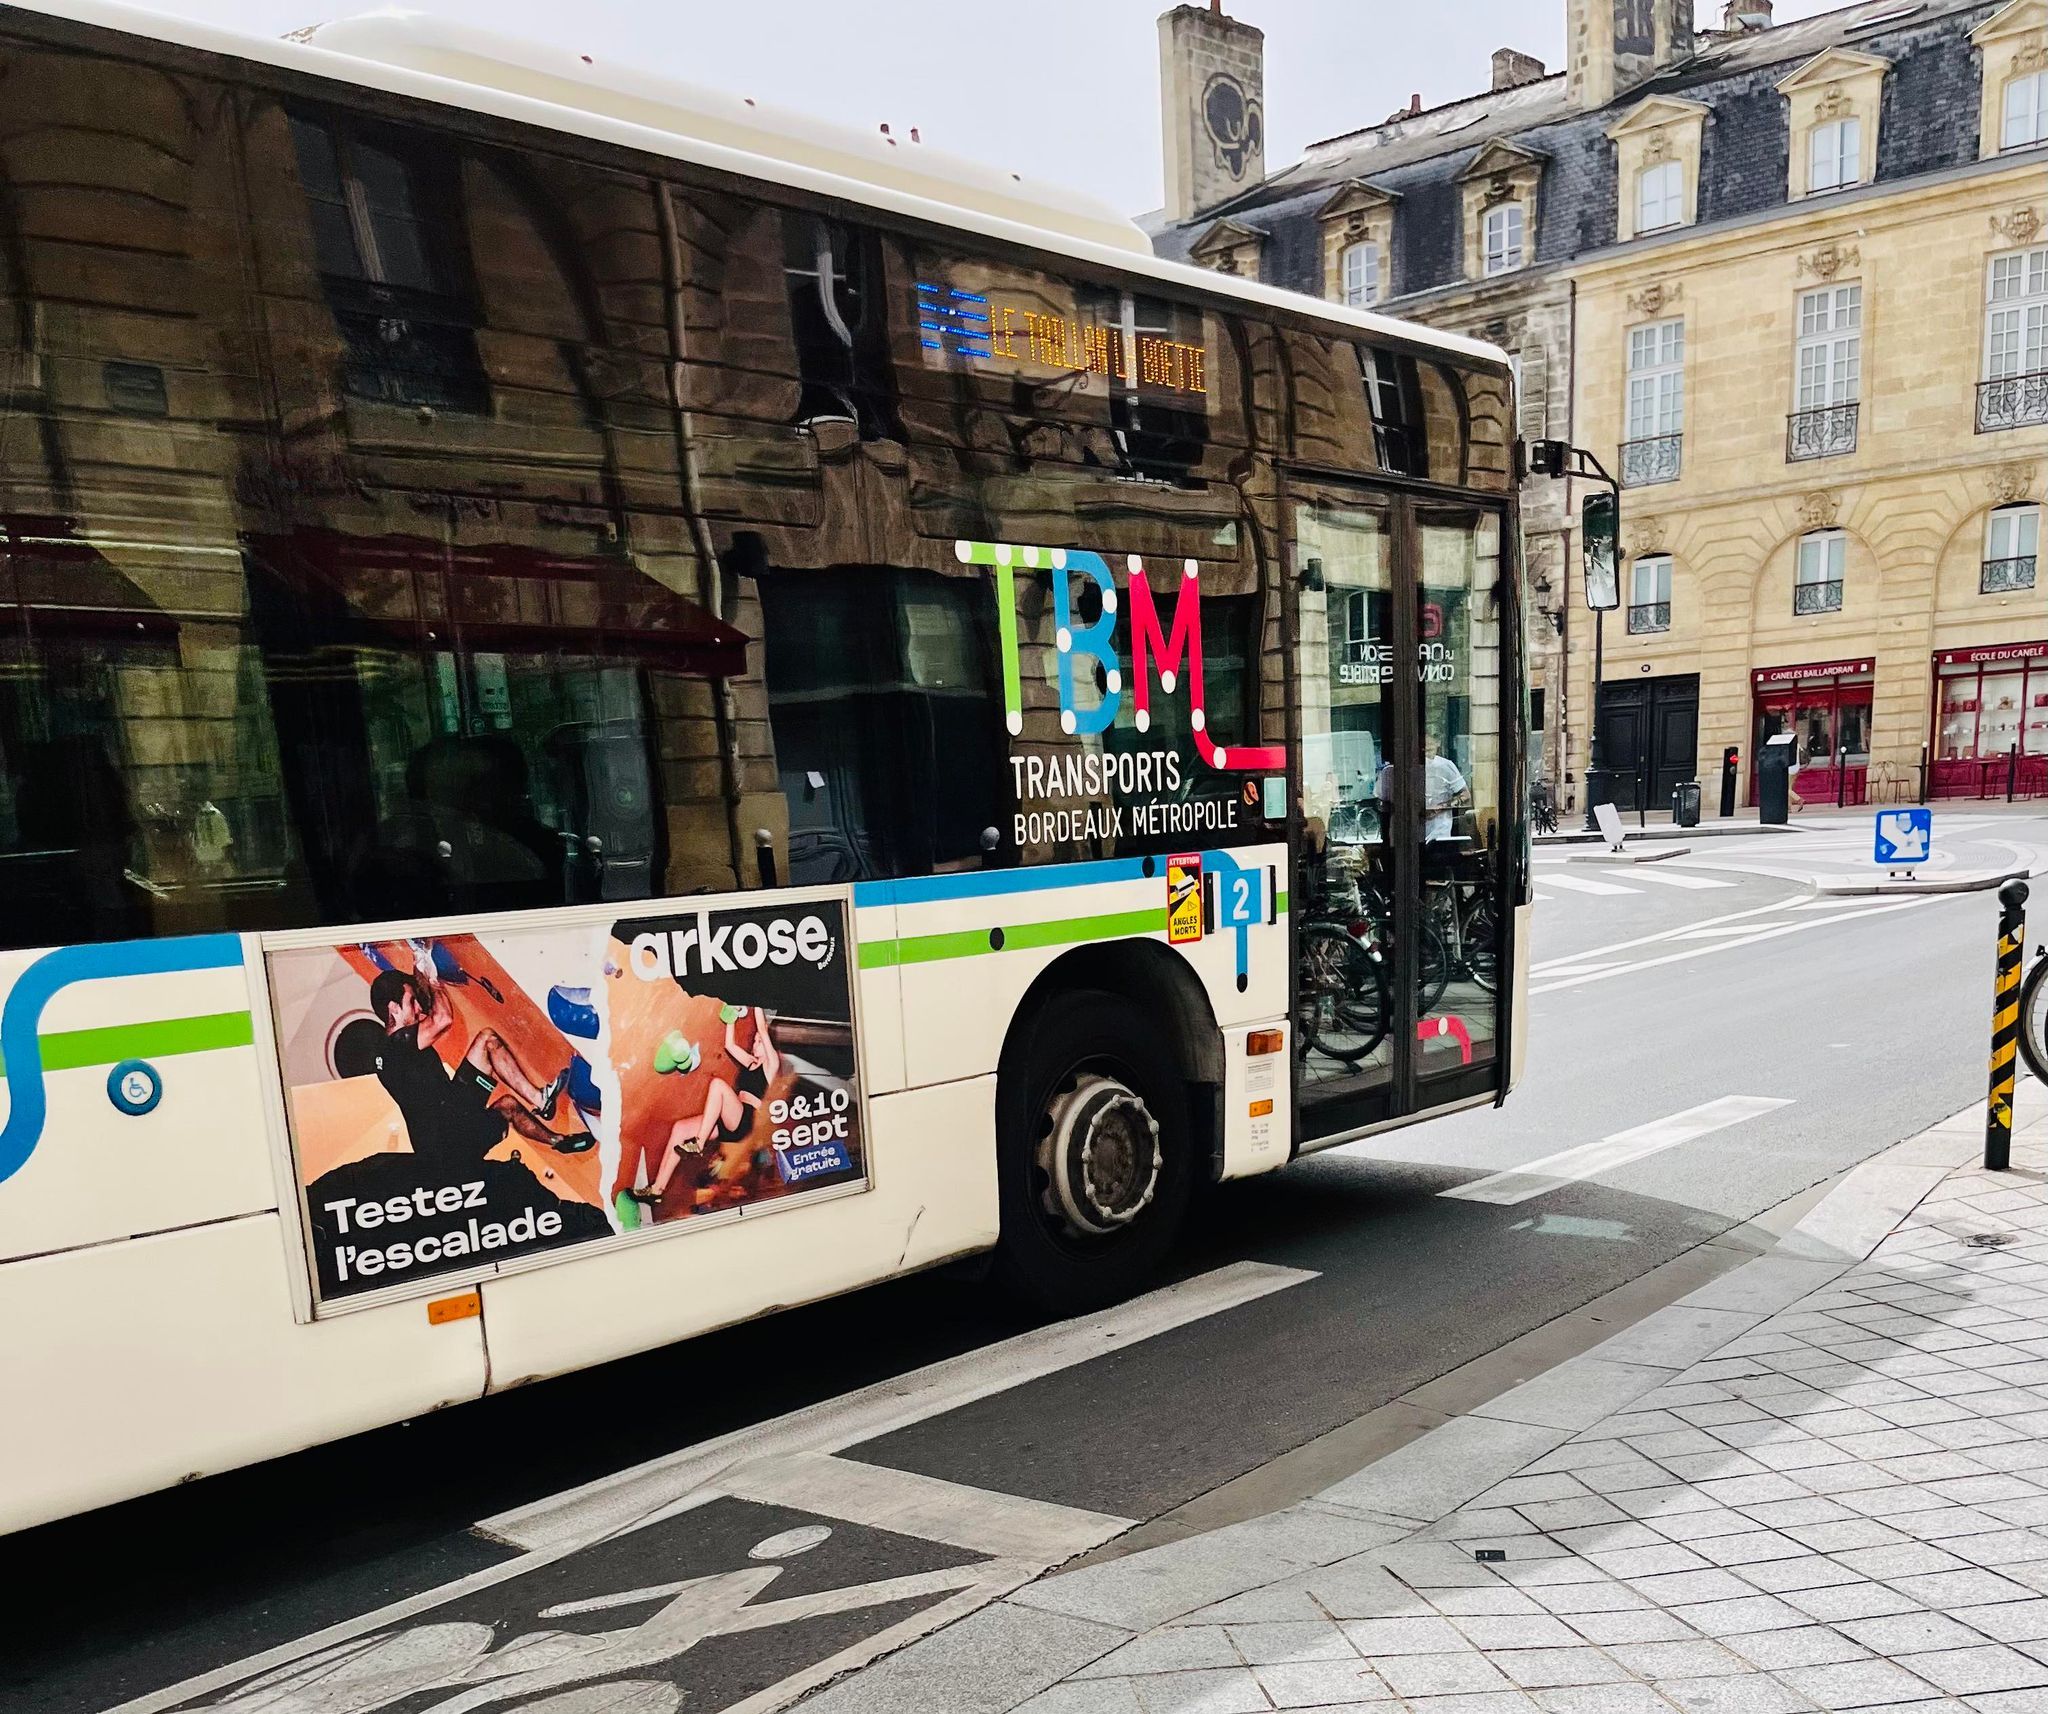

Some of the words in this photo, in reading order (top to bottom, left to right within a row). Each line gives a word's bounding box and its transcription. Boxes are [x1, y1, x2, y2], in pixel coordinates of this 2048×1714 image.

[990, 304, 1019, 359] LE
[954, 539, 1287, 770] TBM
[1803, 665, 1854, 679] BAILLARDRAN
[1970, 651, 1996, 662] ÉCOLE
[1997, 650, 2010, 660] DU
[2011, 645, 2045, 658] CANELÉ
[1009, 750, 1181, 799] TRANSPORTS
[1014, 806, 1124, 846] BORDEAUX
[1132, 798, 1239, 837] MÉTROPOLE
[1168, 855, 1201, 867] ATTENTION
[1232, 877, 1250, 921] 2
[1173, 915, 1198, 926] ANGLES
[1174, 925, 1197, 936] MORTS
[629, 911, 829, 982] arkose
[816, 936, 836, 971] Bordeaux
[768, 1088, 850, 1124] 9&10
[771, 1113, 849, 1151] sept
[790, 1157, 841, 1181] gratuite
[792, 1146, 836, 1166] Entrée
[323, 1180, 488, 1234] Testez
[334, 1206, 563, 1282] l'escalade
